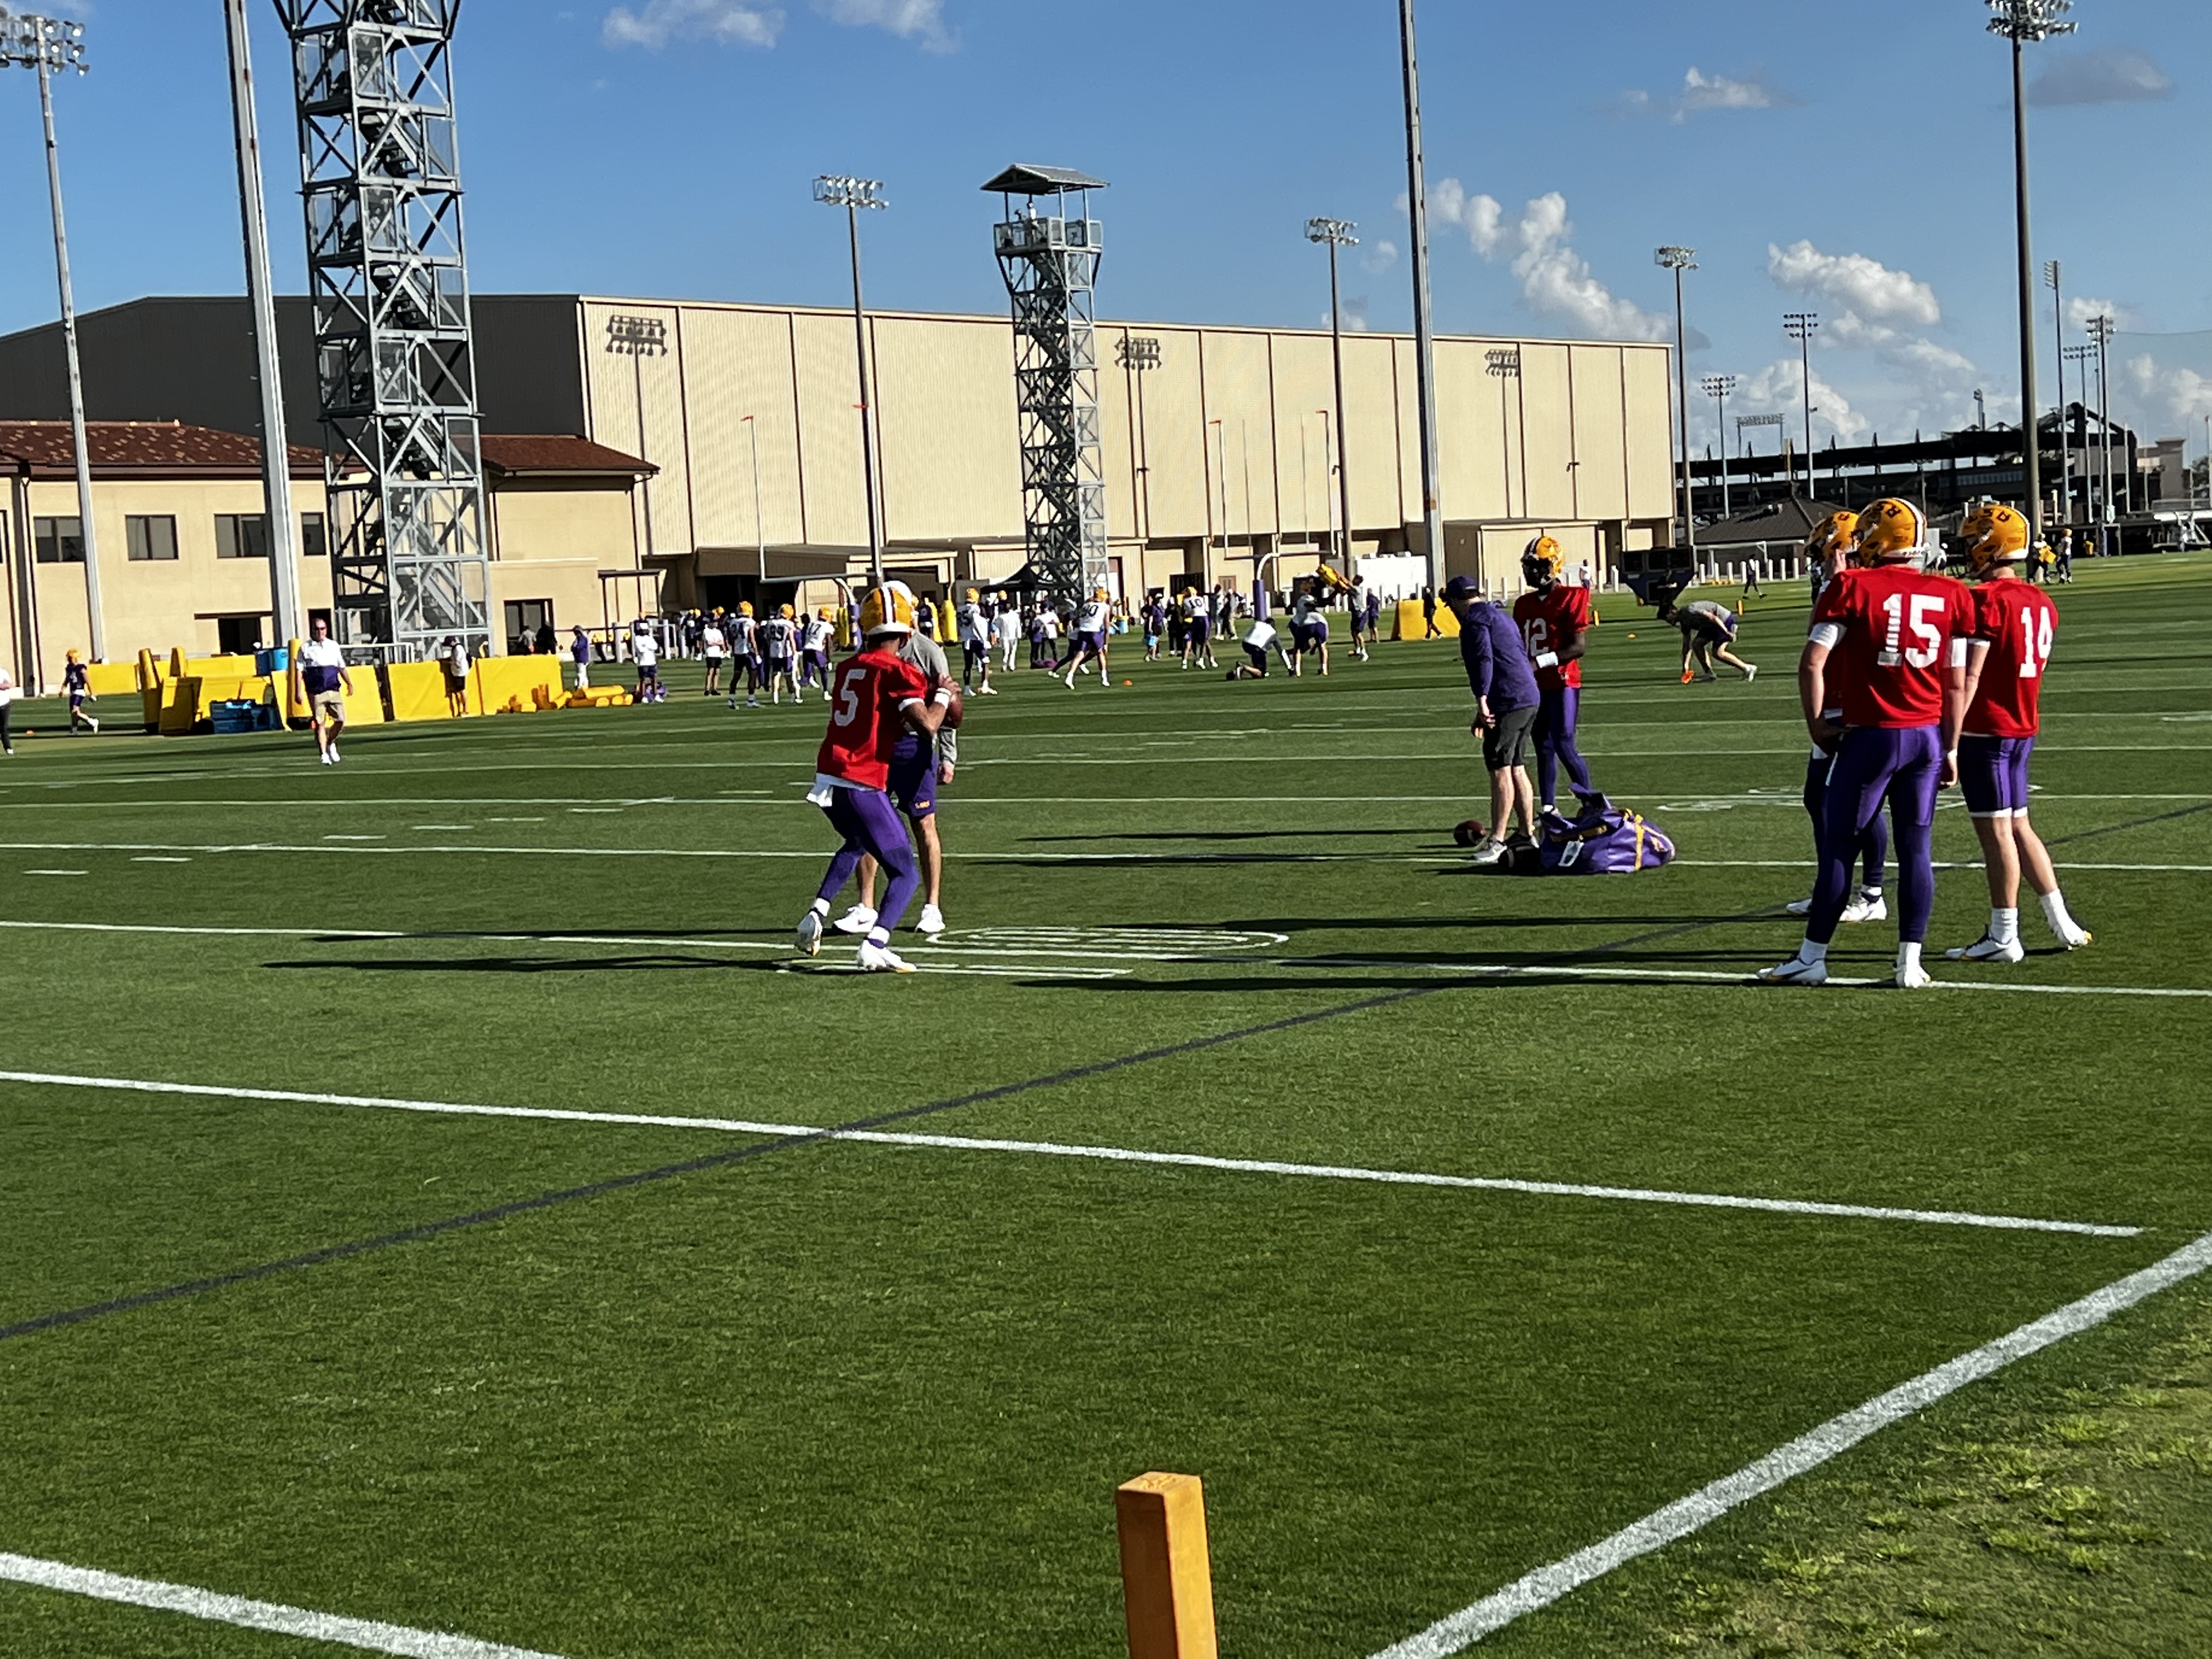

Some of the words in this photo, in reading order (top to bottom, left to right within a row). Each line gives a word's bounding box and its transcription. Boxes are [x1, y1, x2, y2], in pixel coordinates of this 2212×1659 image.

[1523, 618, 1549, 657] 12
[1877, 594, 1944, 668] 15
[2019, 606, 2053, 678] 14
[834, 669, 866, 726] 5
